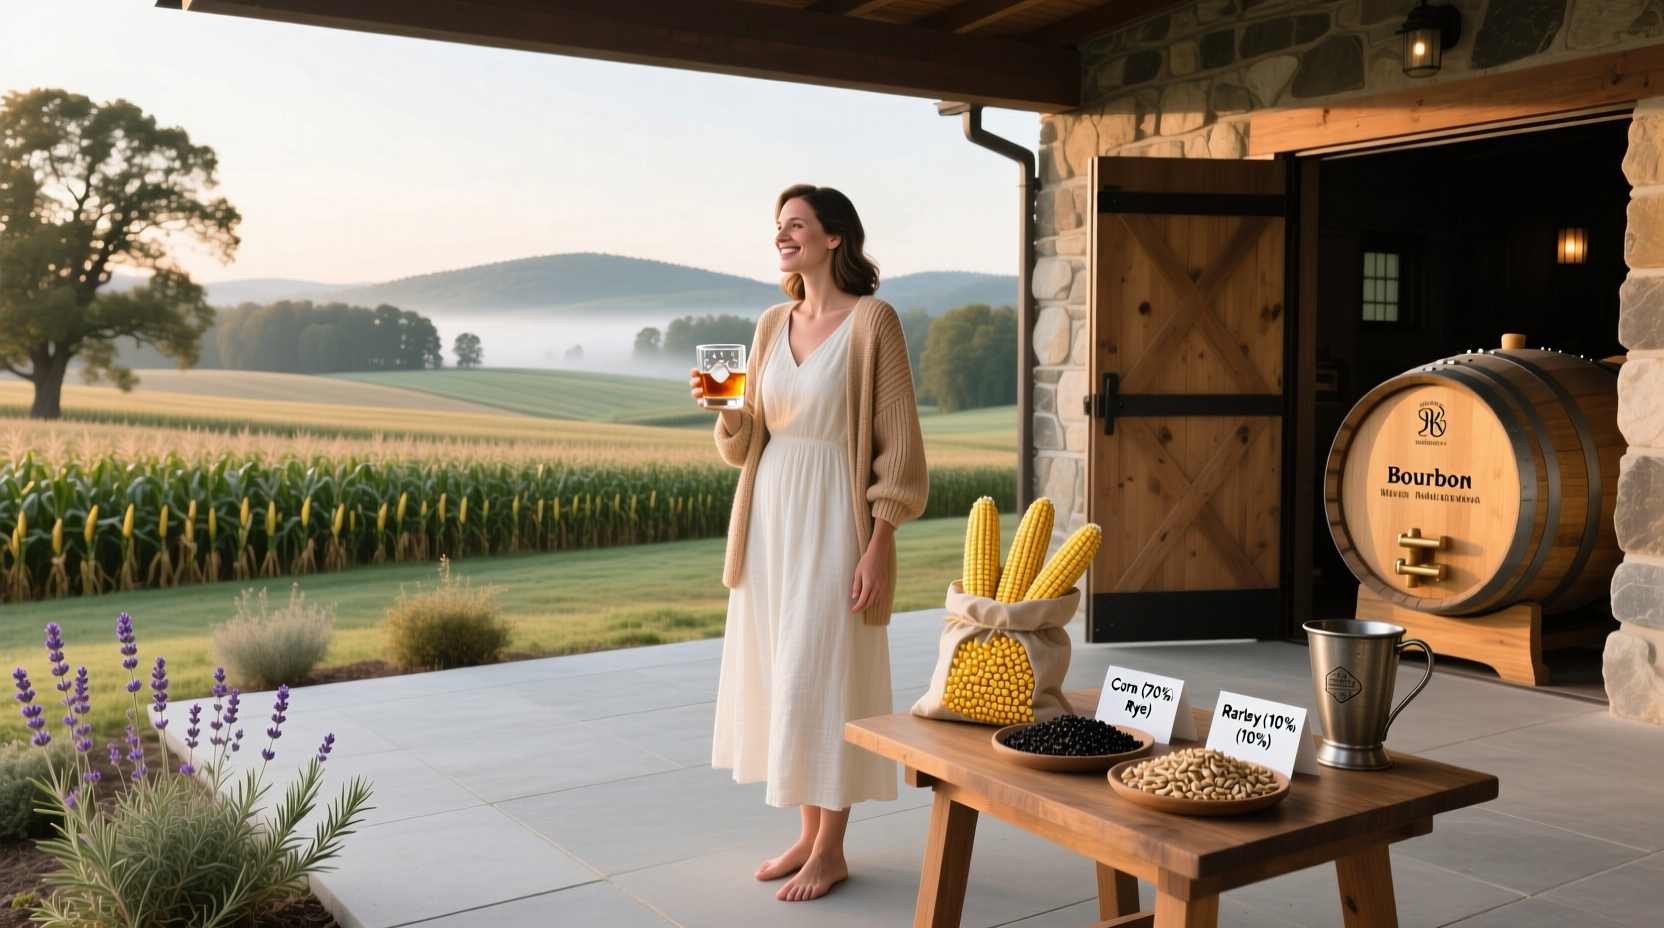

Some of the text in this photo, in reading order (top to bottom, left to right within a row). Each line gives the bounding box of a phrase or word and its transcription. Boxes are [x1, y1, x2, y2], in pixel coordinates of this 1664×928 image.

[1387, 465, 1472, 490] Bourbon
[1124, 699, 1152, 719] Rye)
[1263, 712, 1296, 733] (10%)
[1235, 727, 1272, 751] (10%)
